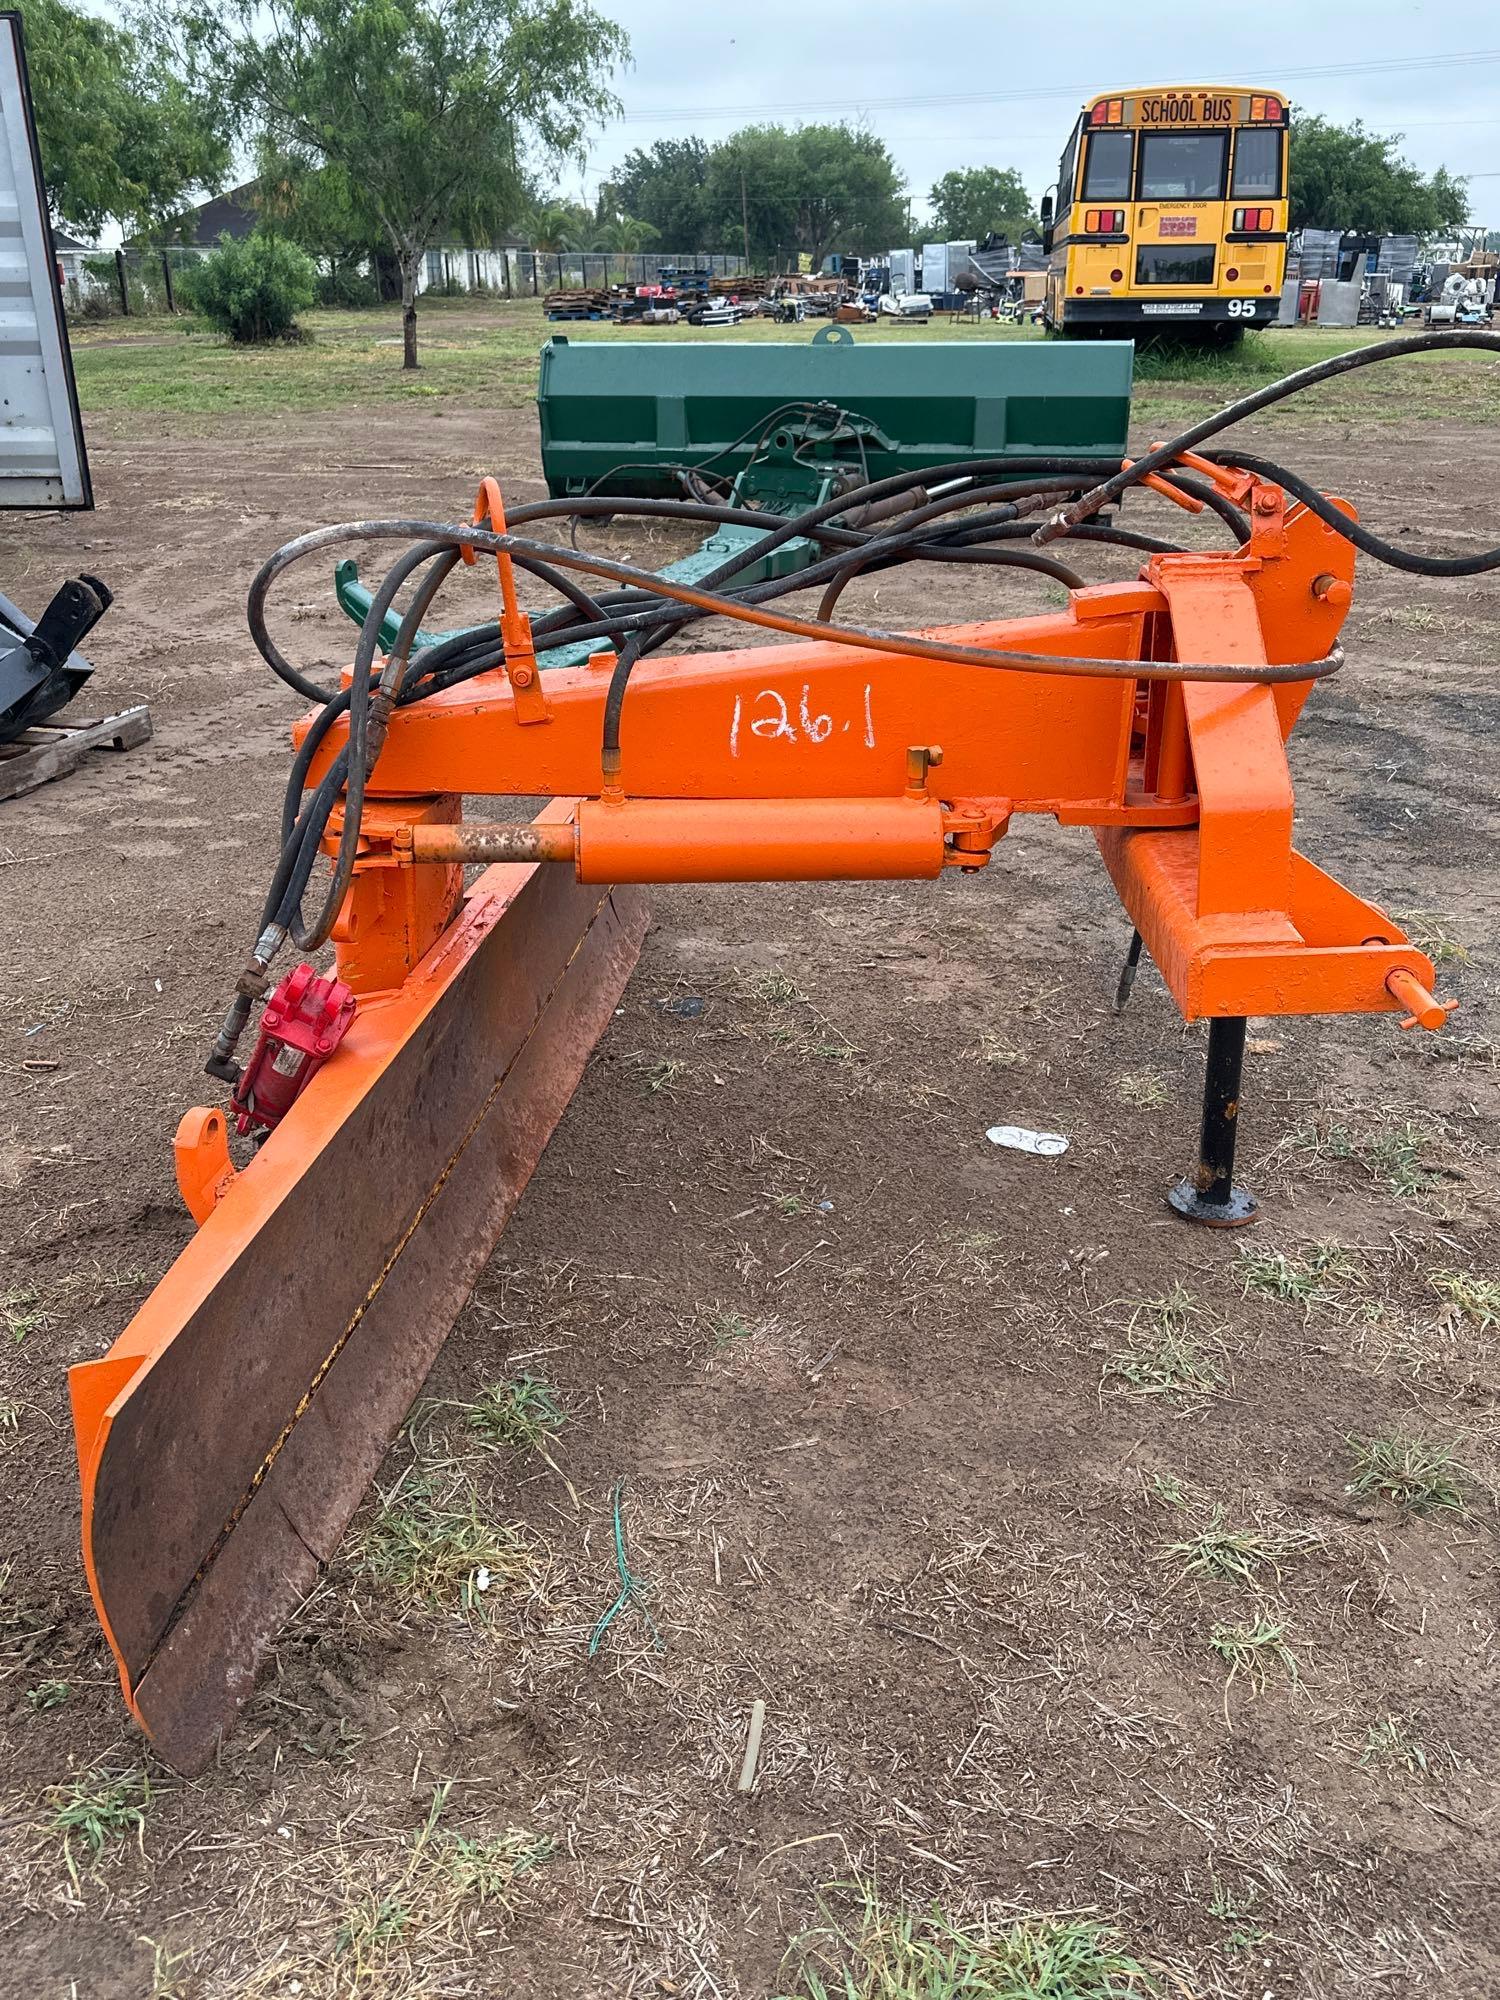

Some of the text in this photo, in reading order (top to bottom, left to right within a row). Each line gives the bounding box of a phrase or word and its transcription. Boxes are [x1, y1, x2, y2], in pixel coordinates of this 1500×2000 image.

[1141, 99, 1232, 122] SCHOOL BUS
[1227, 299, 1257, 318] 95
